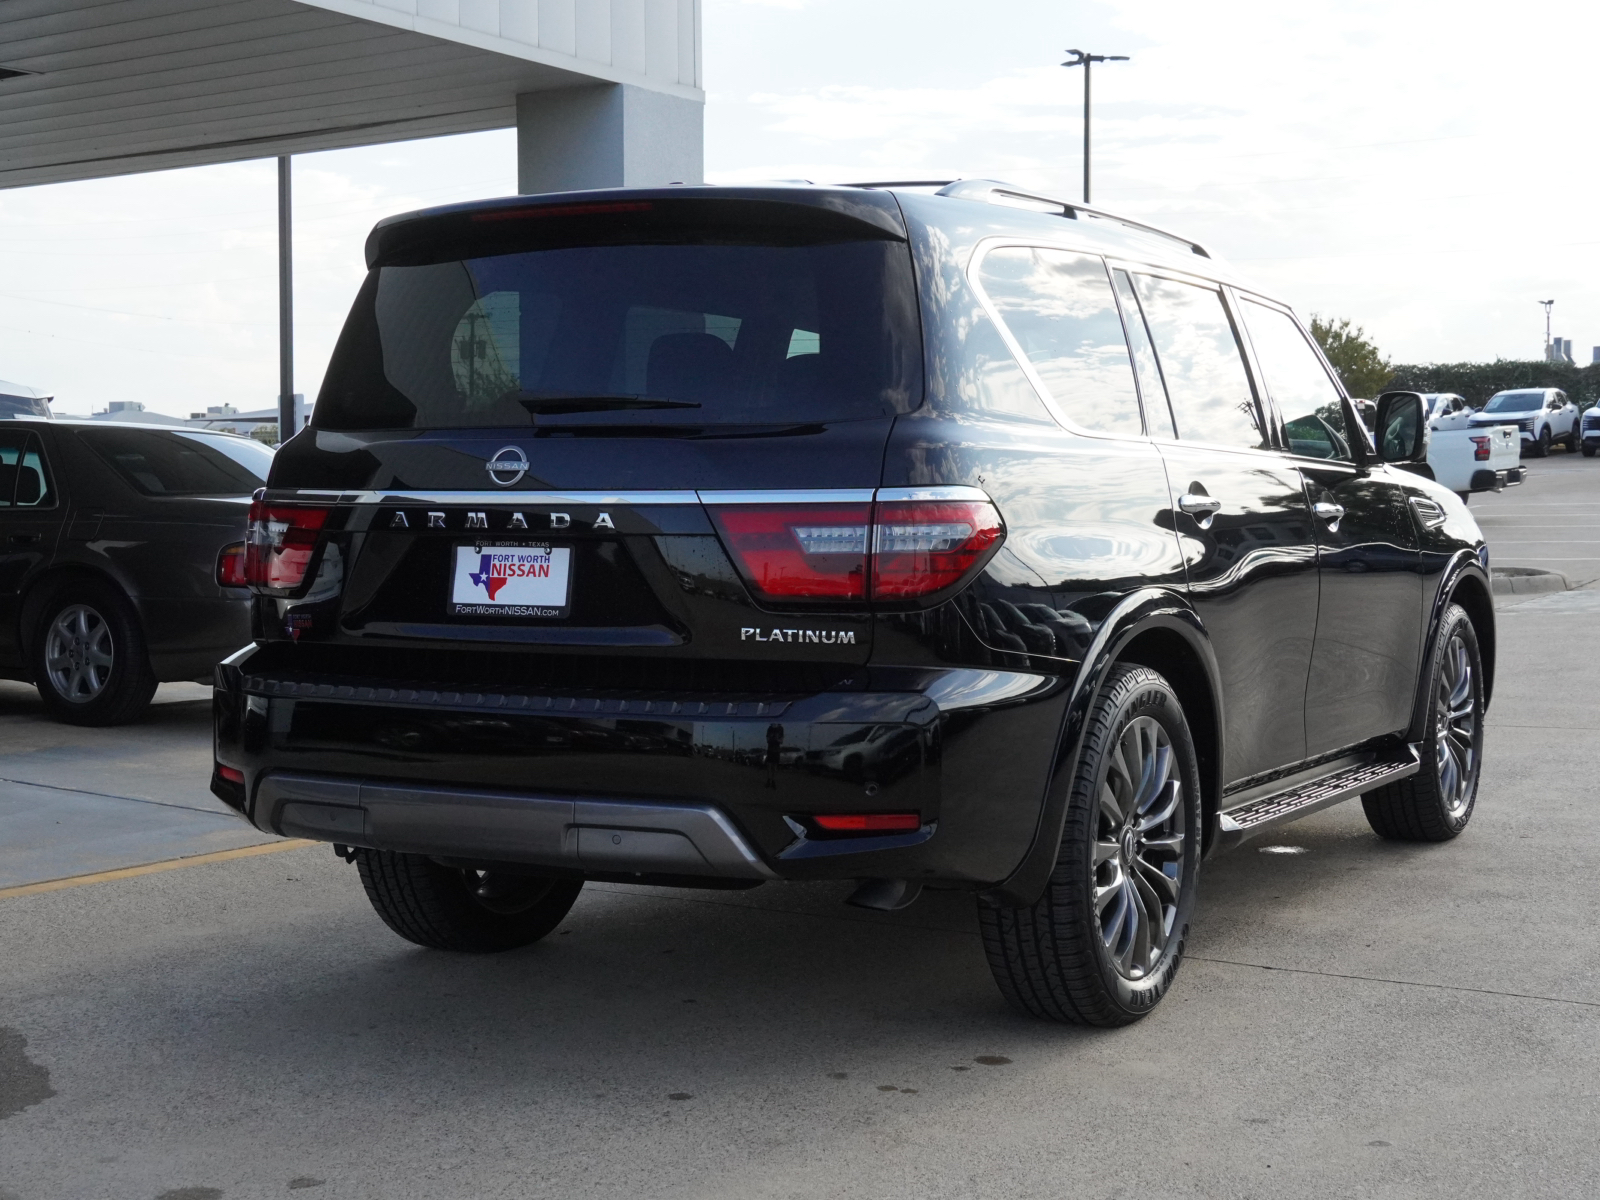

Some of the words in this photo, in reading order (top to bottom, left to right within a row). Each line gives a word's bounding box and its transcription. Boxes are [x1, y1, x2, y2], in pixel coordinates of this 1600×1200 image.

[486, 462, 528, 470] NISSAN
[390, 511, 615, 529] ARMADA
[492, 554, 516, 563] FORT
[518, 555, 551, 564] WORTH
[491, 563, 551, 578] NISSAN
[740, 627, 856, 645] PLATINUM
